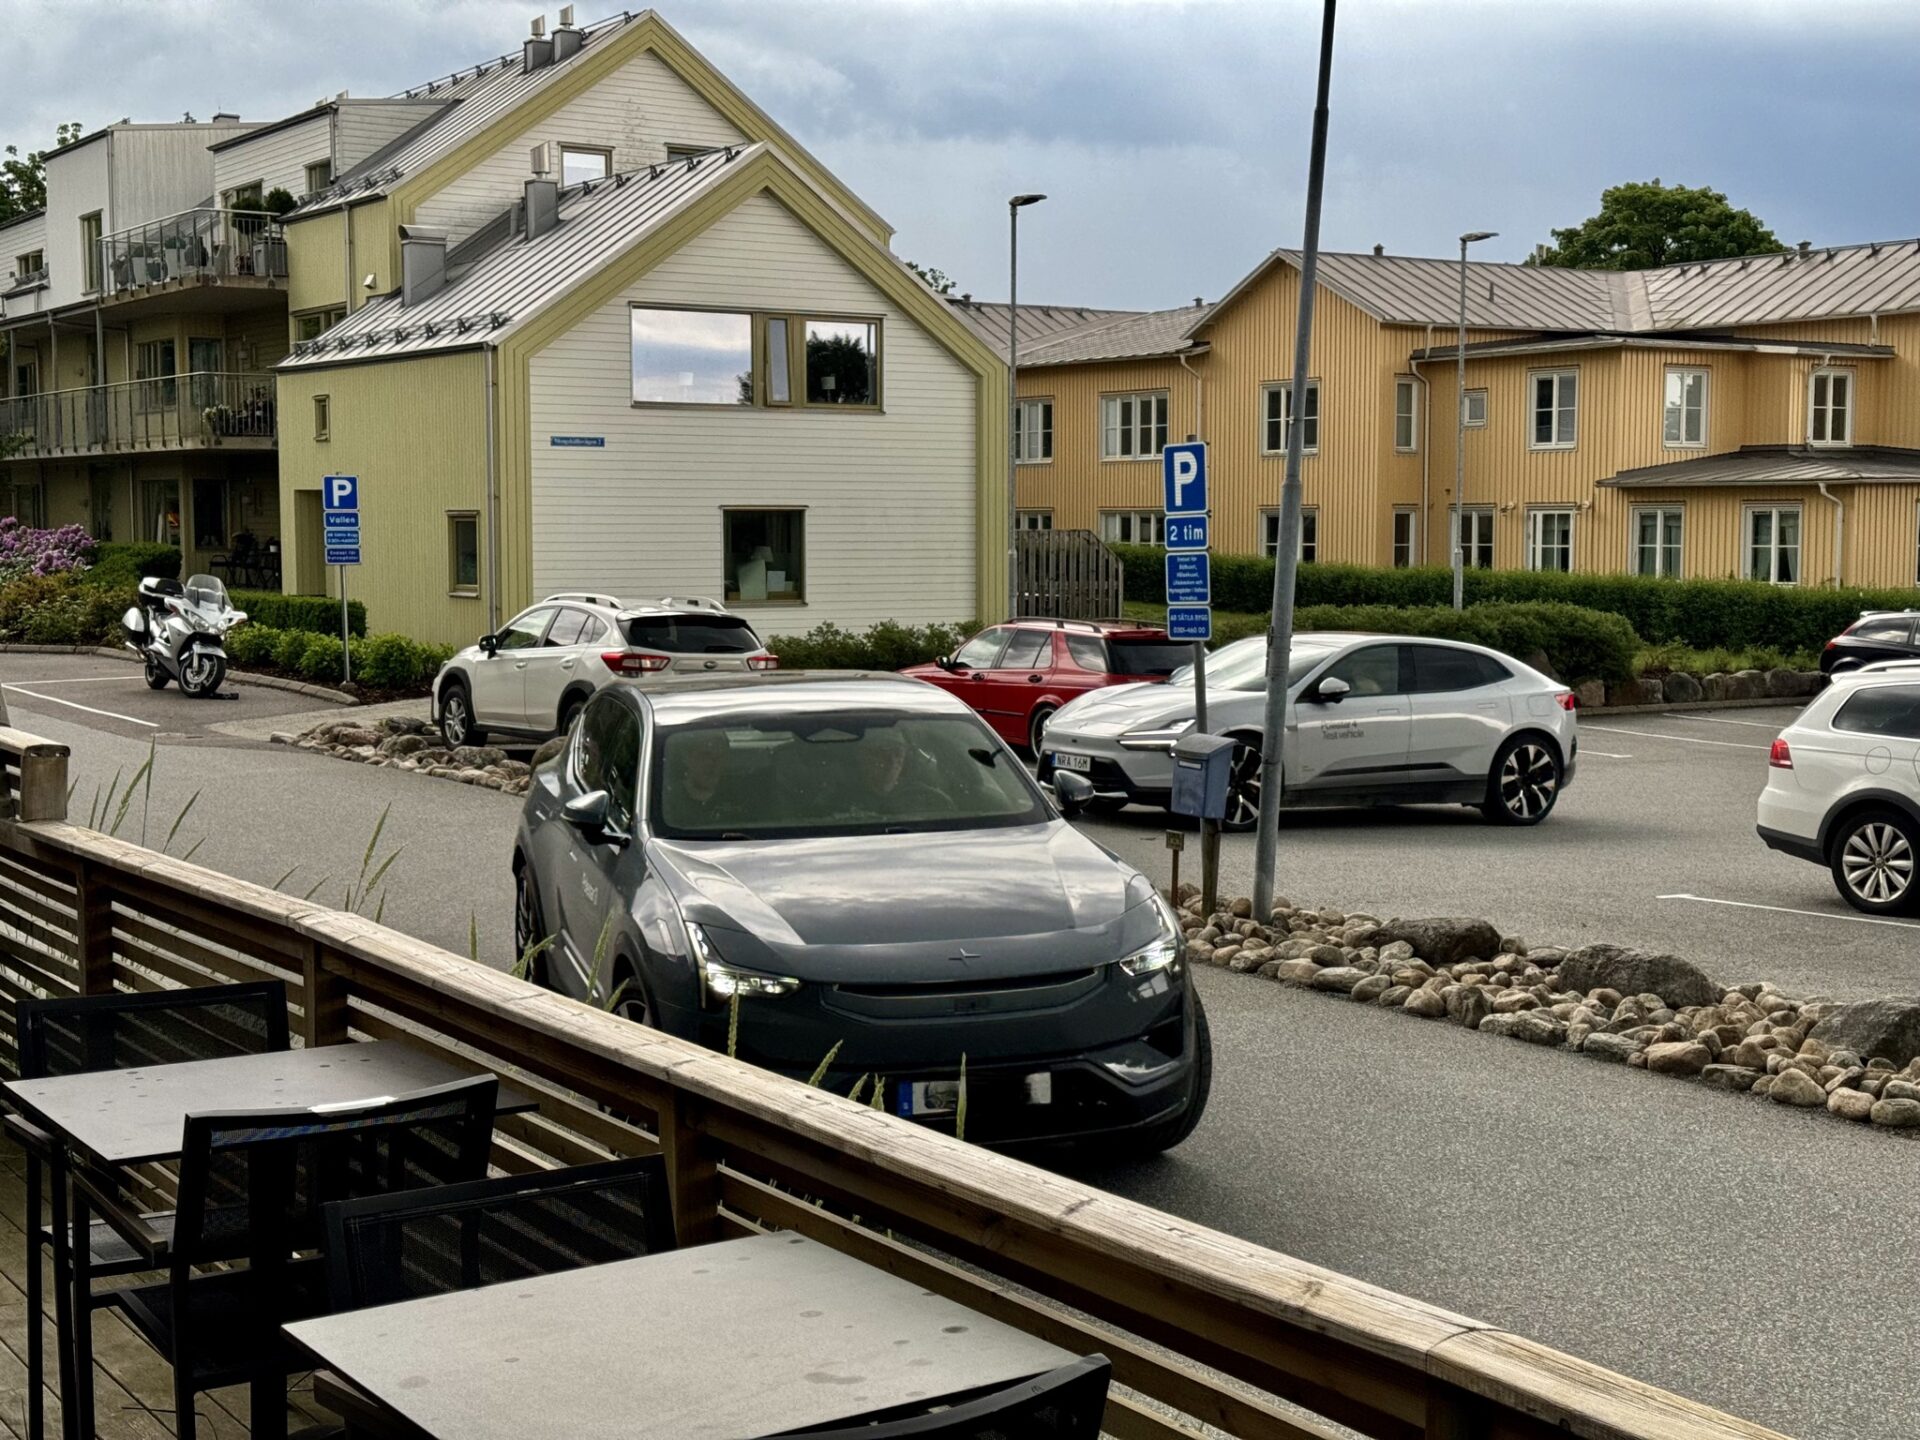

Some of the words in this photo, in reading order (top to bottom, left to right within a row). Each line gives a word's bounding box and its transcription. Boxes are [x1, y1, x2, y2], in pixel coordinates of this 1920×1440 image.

[1173, 451, 1198, 507] P
[332, 479, 353, 507] P
[329, 515, 356, 524] Vallen
[1169, 525, 1178, 541] 2
[1183, 524, 1204, 541] tim
[1322, 730, 1338, 740] Test
[1057, 754, 1071, 767] NRA
[1074, 757, 1088, 769] 16M
